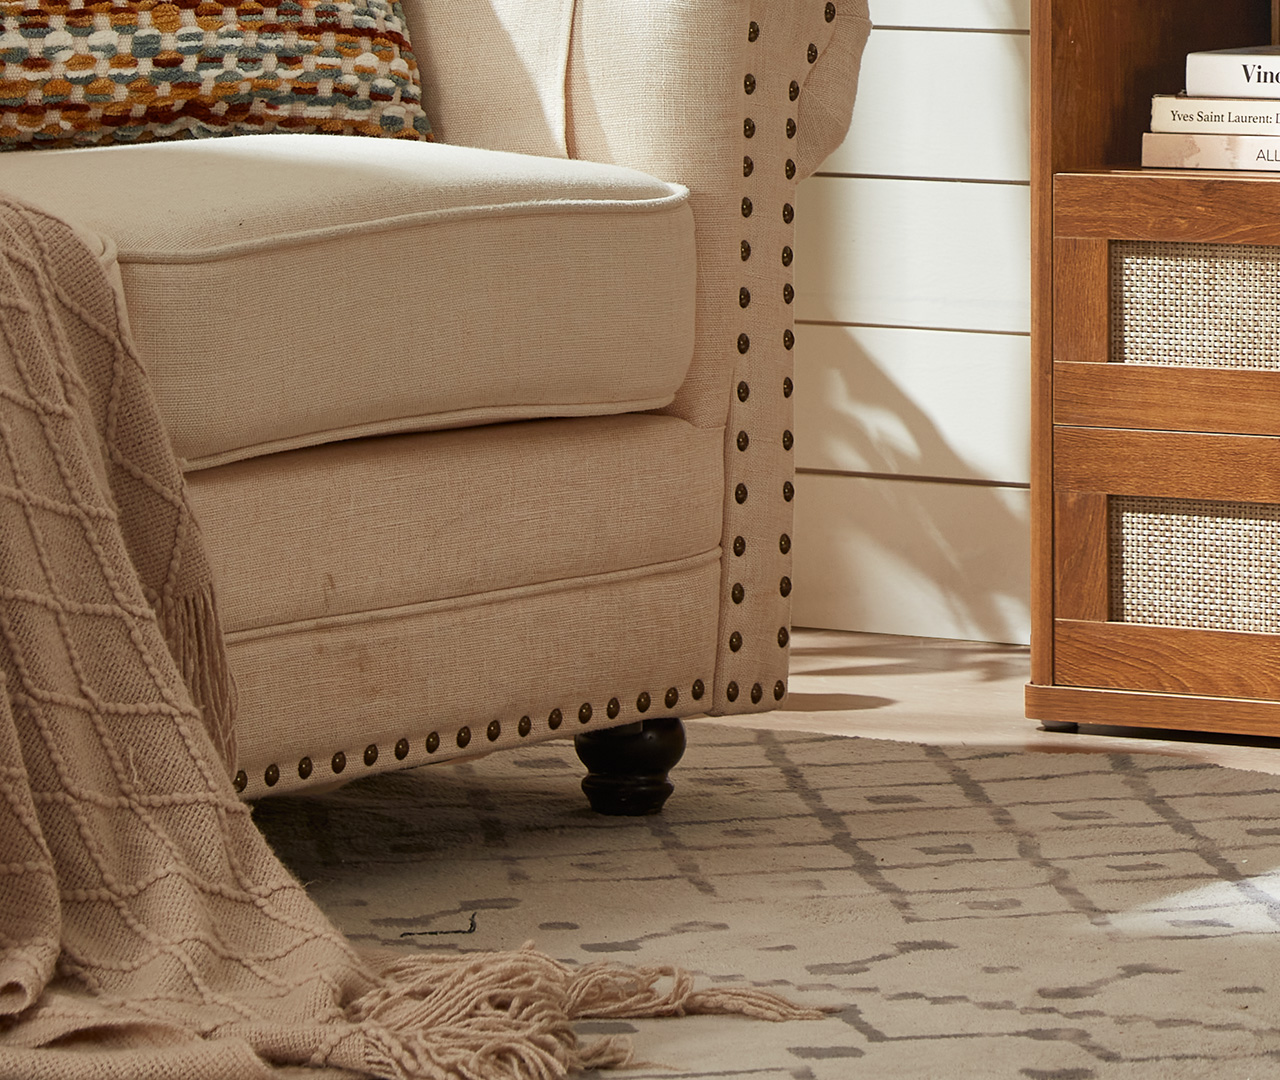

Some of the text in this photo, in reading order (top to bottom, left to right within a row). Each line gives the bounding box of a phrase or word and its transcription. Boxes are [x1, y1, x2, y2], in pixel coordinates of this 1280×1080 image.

[1170, 109, 1194, 123] Yves
[1196, 109, 1225, 124] Saint
[1227, 111, 1273, 125] Laurent:
